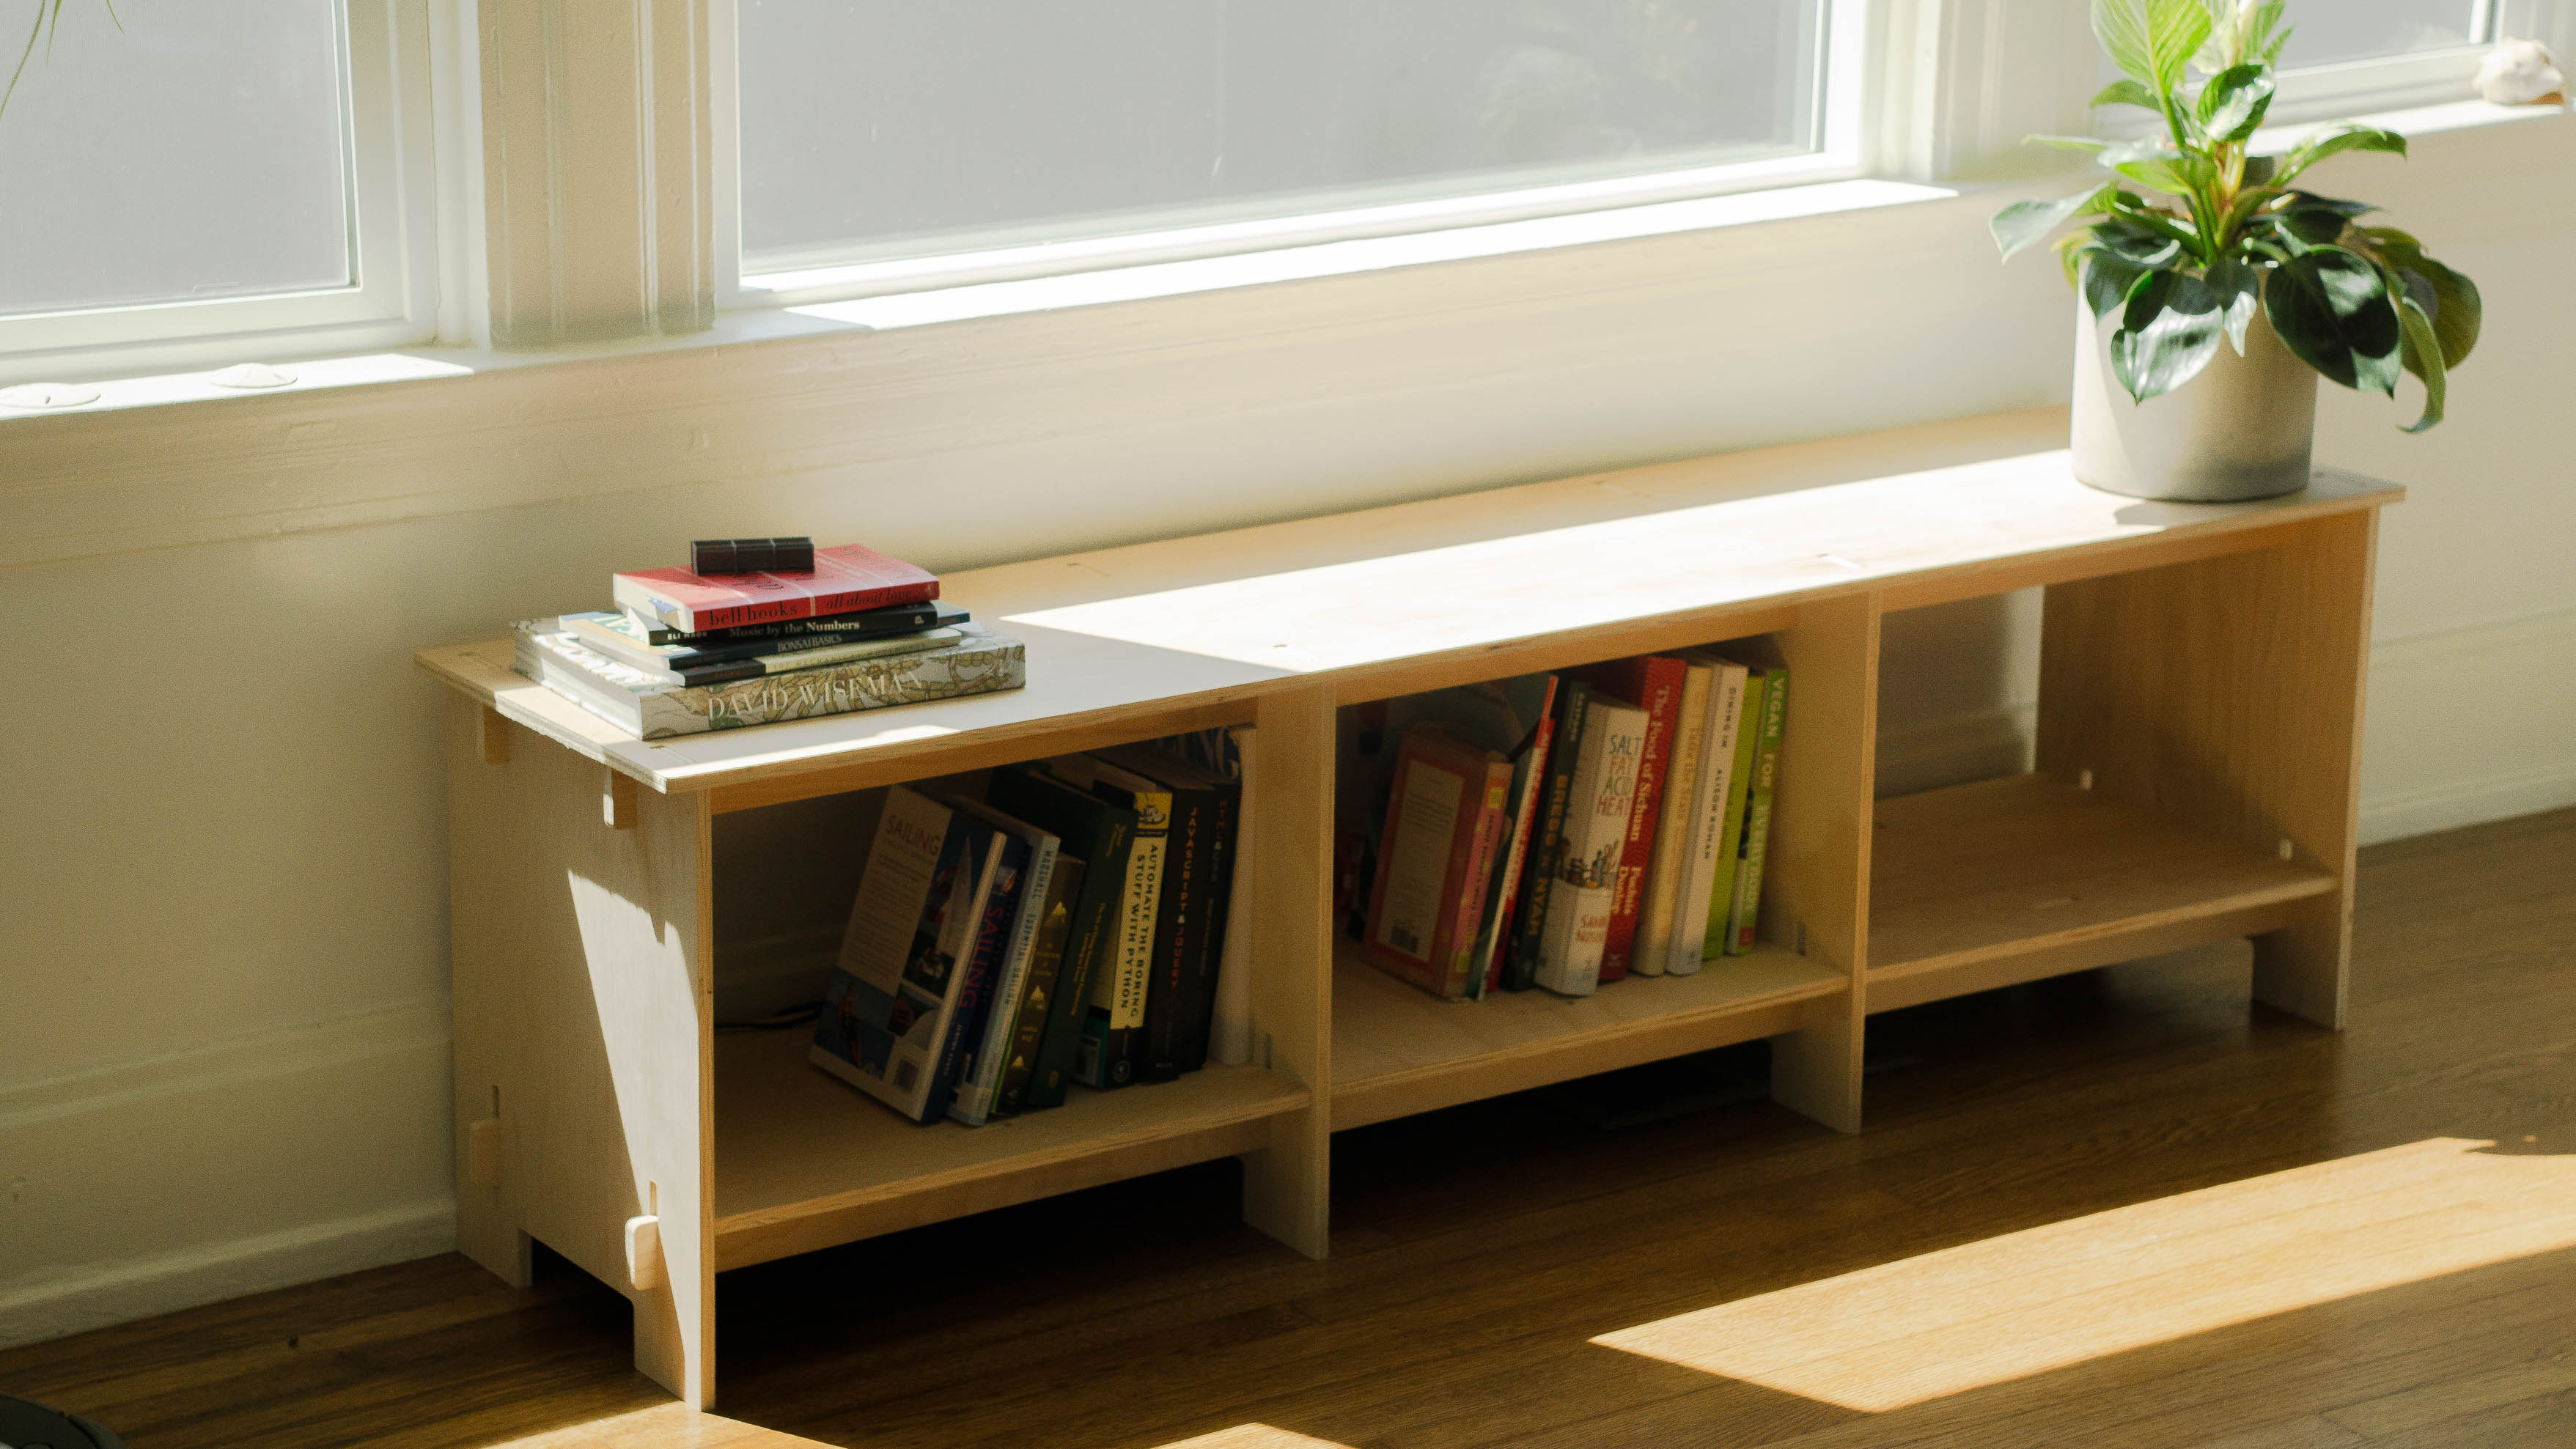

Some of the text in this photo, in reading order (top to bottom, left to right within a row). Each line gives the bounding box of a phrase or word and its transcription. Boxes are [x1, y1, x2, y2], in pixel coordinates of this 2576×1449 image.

[710, 601, 797, 626] bell hooks
[826, 588, 911, 610] all about love
[729, 620, 861, 639] Music by the Numbers
[708, 669, 923, 721] DAVID WISEMAN
[1721, 687, 1737, 748] DINING IN
[1767, 677, 1785, 737] VEGAN
[1608, 734, 1642, 756] SALT
[1630, 686, 1670, 841] The Food of Sichuan
[1760, 753, 1774, 788] FOR
[886, 814, 941, 856] SAILING
[1704, 768, 1723, 859] ALISON ROMAN
[1034, 849, 1053, 899] MARSHALL
[1143, 844, 1158, 921] AUTOMATE
[1180, 806, 1198, 912] JAVASCRIPT
[1121, 854, 1144, 1009] STUFF WITH PYTHON
[1528, 877, 1547, 936] NYAM
[959, 904, 1004, 1009] SAILING
[1140, 926, 1149, 950] THE
[1170, 926, 1185, 988] JQUERY
[1130, 959, 1144, 1018] BORING
